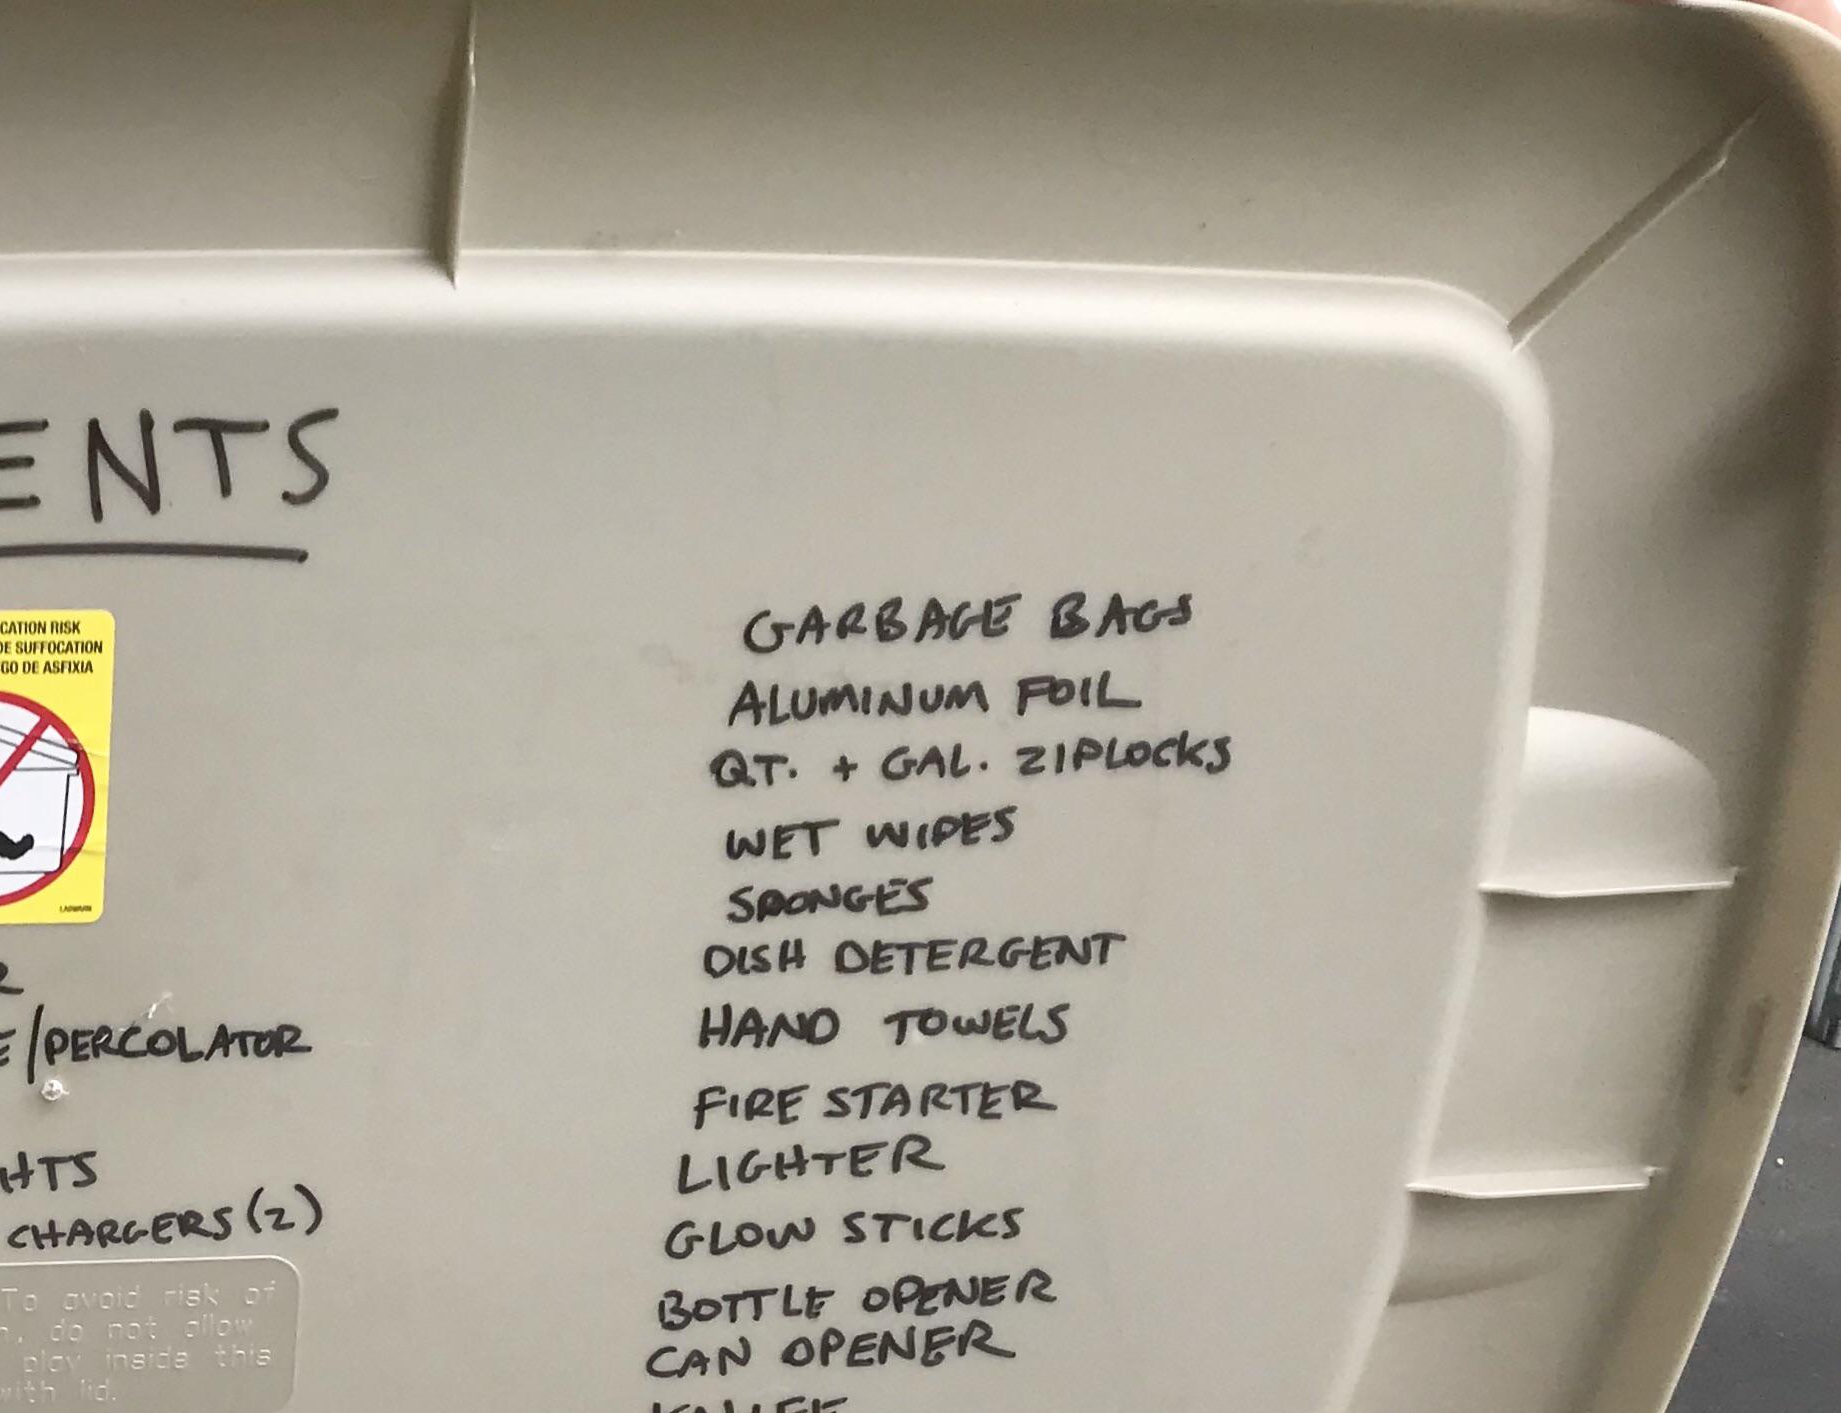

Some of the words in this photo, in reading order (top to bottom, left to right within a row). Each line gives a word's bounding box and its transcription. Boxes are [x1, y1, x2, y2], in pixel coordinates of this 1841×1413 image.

[50, 621, 81, 635] RISK
[743, 593, 1022, 655] GARBAGE
[1050, 592, 1192, 640] BAGS
[15, 640, 103, 654] SUFFOCATION
[22, 661, 39, 674] DE
[42, 660, 94, 674] ASFIXIA
[728, 680, 989, 727] ALUMINUM
[1017, 670, 1142, 716] FOIL
[709, 749, 797, 788] QT.
[833, 755, 858, 782] +
[880, 743, 988, 782] GAL.
[1016, 730, 1231, 776] ZIPLOCKS
[726, 819, 840, 860] WET
[866, 805, 1017, 850] WIPES
[726, 877, 933, 923] SPONGES
[703, 938, 806, 979] DISH
[834, 932, 1127, 975] DETERGENT
[698, 1003, 840, 1049] HAND
[883, 1003, 1070, 1046] TOWELS
[693, 1084, 810, 1130] FIRE
[823, 1080, 1057, 1120] STARTER
[678, 1133, 945, 1195] LIGHTER
[7, 1207, 233, 1250] CHARGERS
[664, 1217, 815, 1260] GLOW
[843, 1207, 1024, 1244] STICKS
[1, 1288, 38, 1312] To
[63, 1284, 140, 1311] avoid
[164, 1283, 219, 1307] risk
[245, 1280, 278, 1305] of
[658, 1284, 835, 1331] BOTTLE
[862, 1268, 1057, 1316] OPENER
[51, 1318, 83, 1342] do
[108, 1316, 161, 1341] not
[184, 1314, 254, 1338] allow
[646, 1336, 751, 1378] CAN
[780, 1319, 1016, 1367] OPENER
[23, 1350, 81, 1378] play
[106, 1347, 189, 1371] inside
[216, 1344, 272, 1368] this
[80, 1379, 117, 1403] lid.
